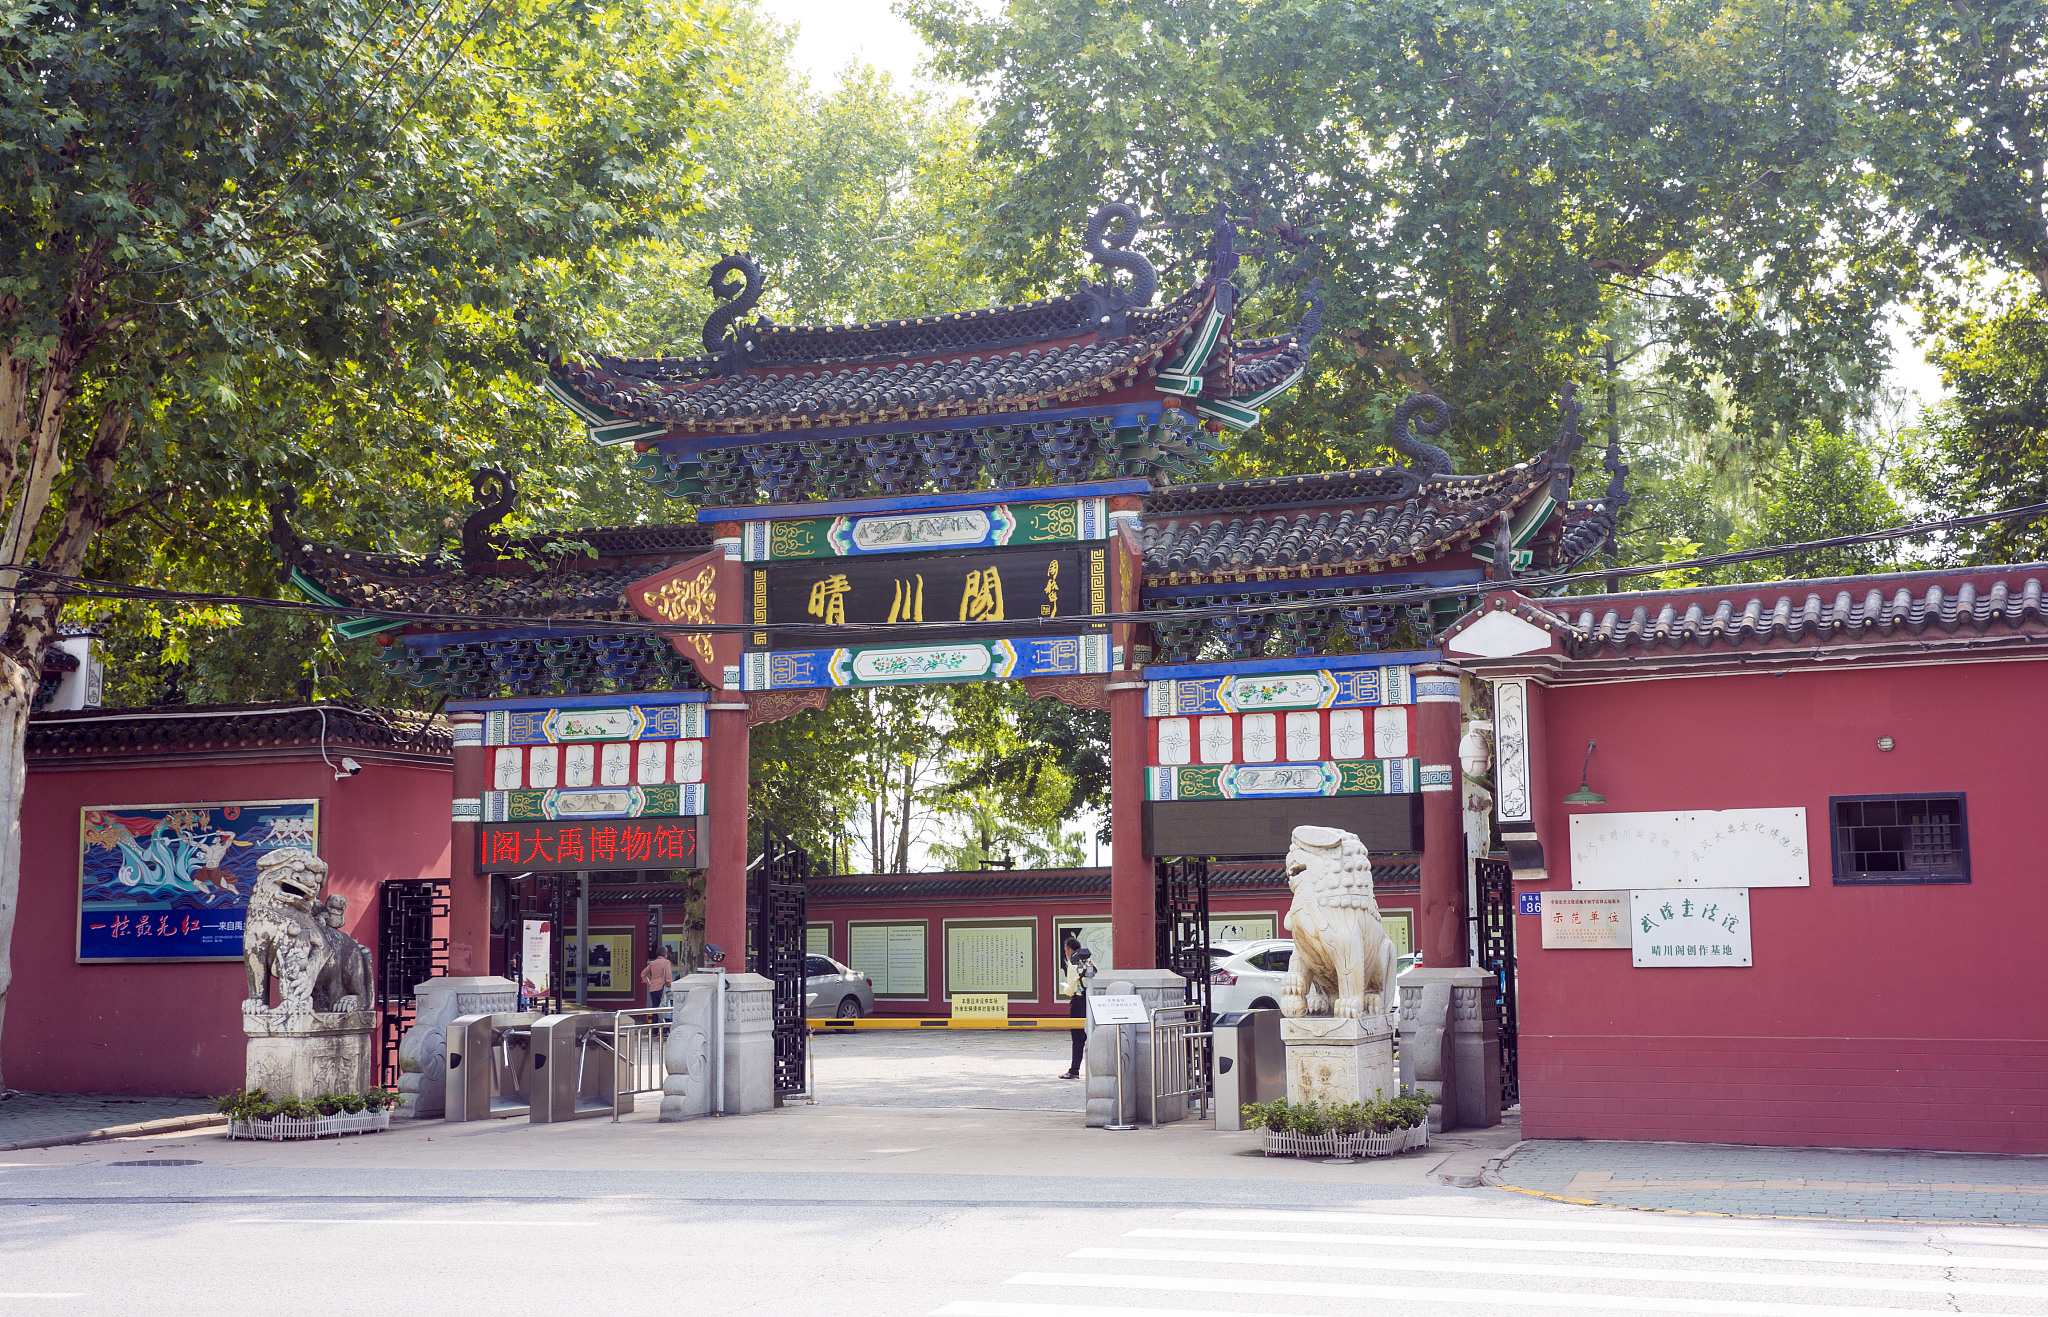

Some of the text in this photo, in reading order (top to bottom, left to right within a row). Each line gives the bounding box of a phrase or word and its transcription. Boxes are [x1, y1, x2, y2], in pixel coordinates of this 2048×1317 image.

[1527, 902, 1541, 913] 86
[1553, 910, 1619, 925] 示范单位
[1651, 944, 1733, 956] 晴川阁创作基地
